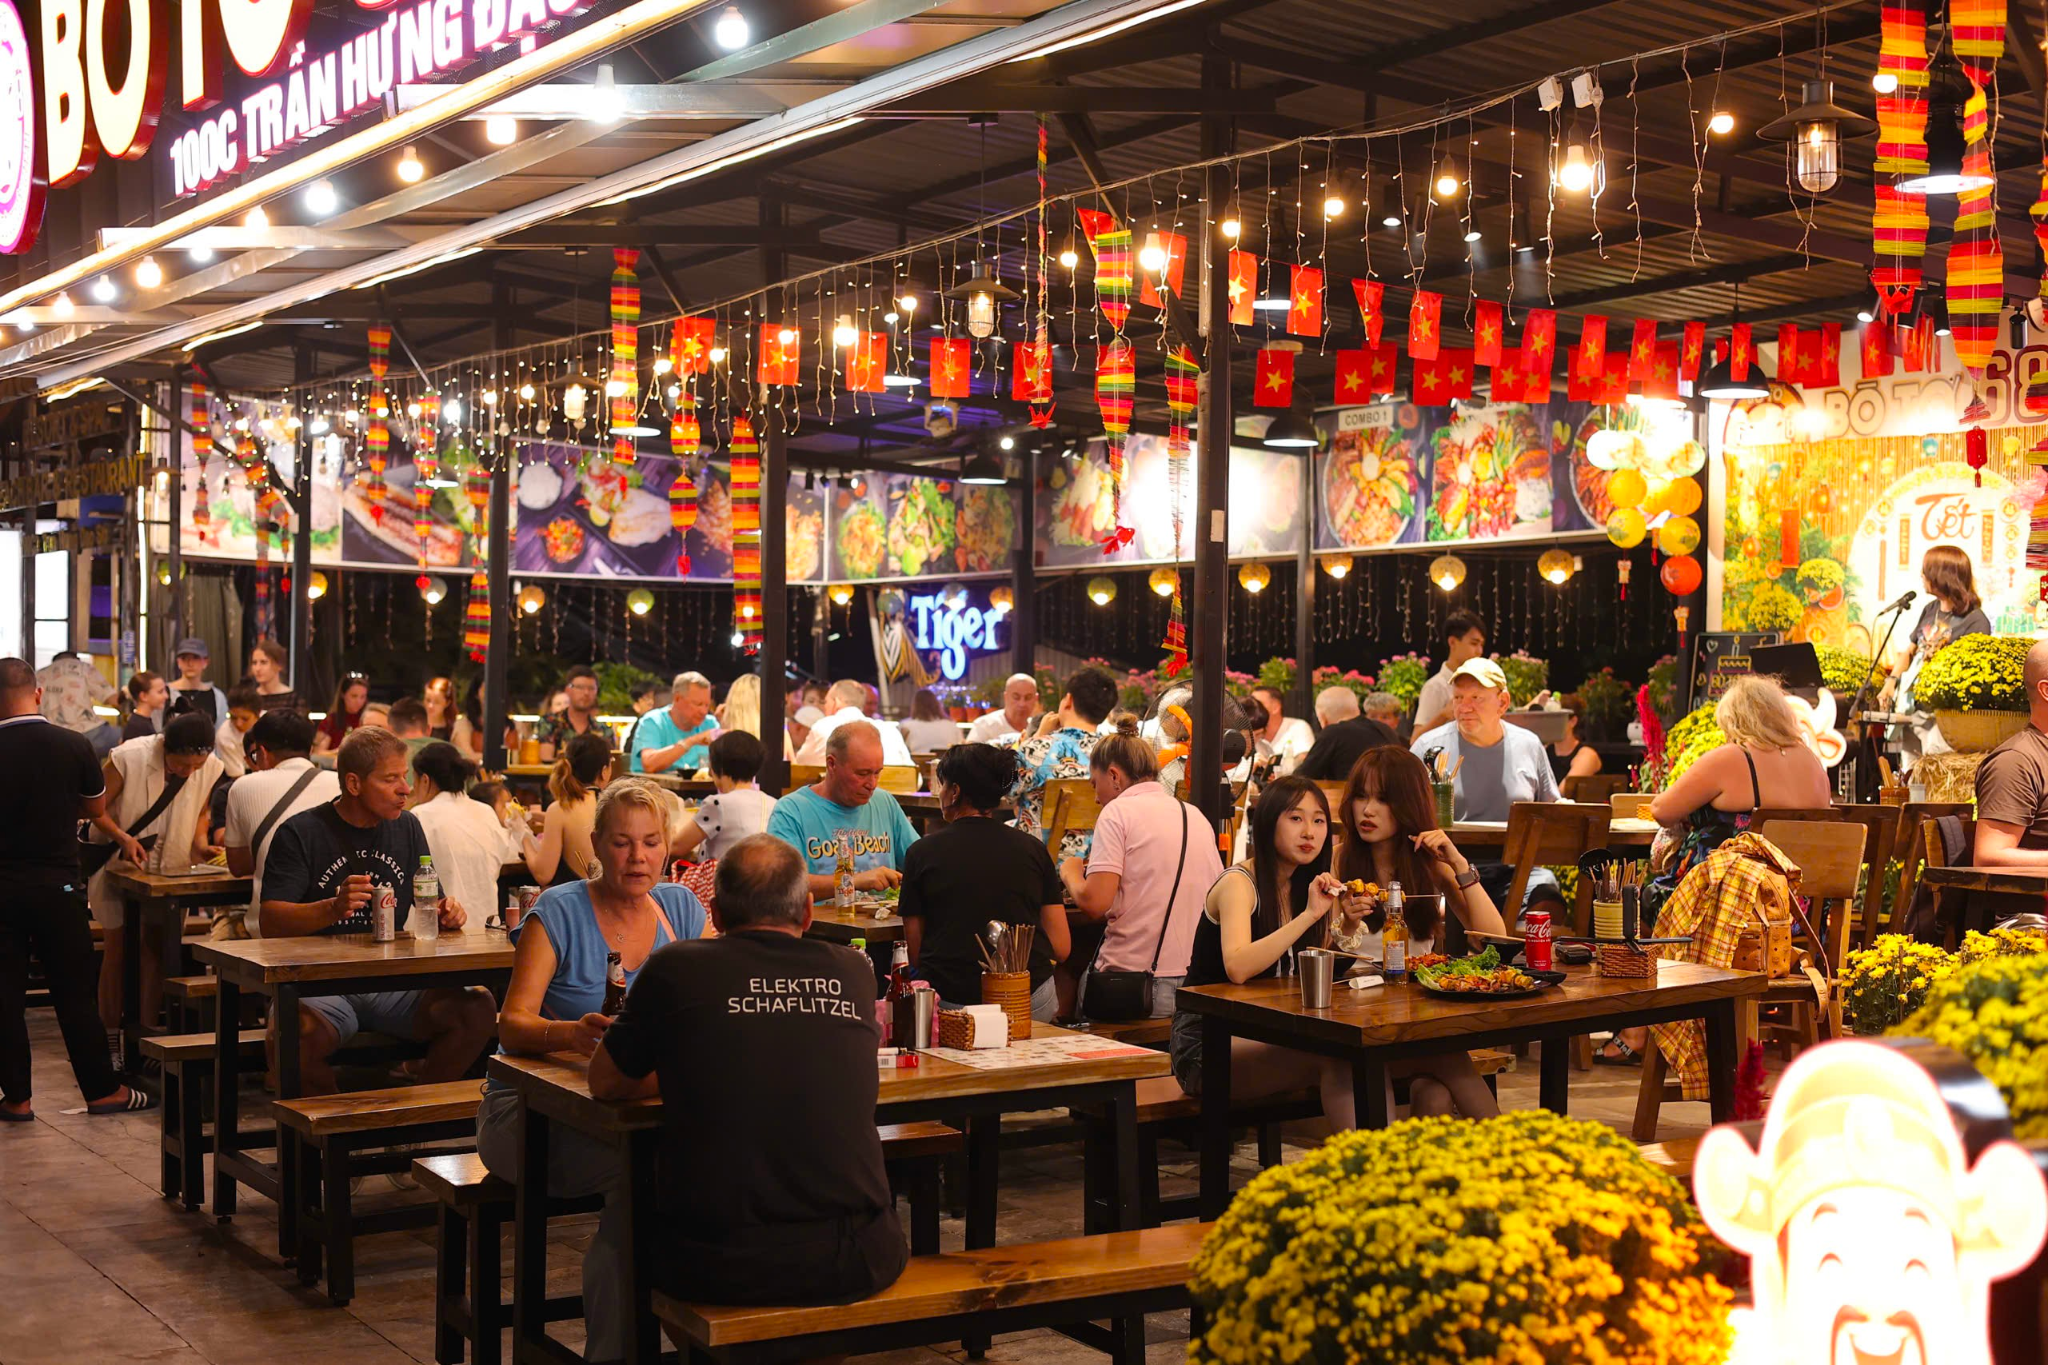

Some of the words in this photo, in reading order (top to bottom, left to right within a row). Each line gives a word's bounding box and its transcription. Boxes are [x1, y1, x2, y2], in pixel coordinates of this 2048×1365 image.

[170, 108, 238, 196] 100C
[1344, 413, 1380, 427] COMBO
[65, 453, 146, 500] RESTAURANT
[1915, 493, 1977, 541] Tết
[911, 589, 1004, 680] Tiger
[854, 831, 891, 856] Beach
[749, 978, 842, 996] ELEKTRO
[728, 997, 862, 1021] SCHAFLITZEL
